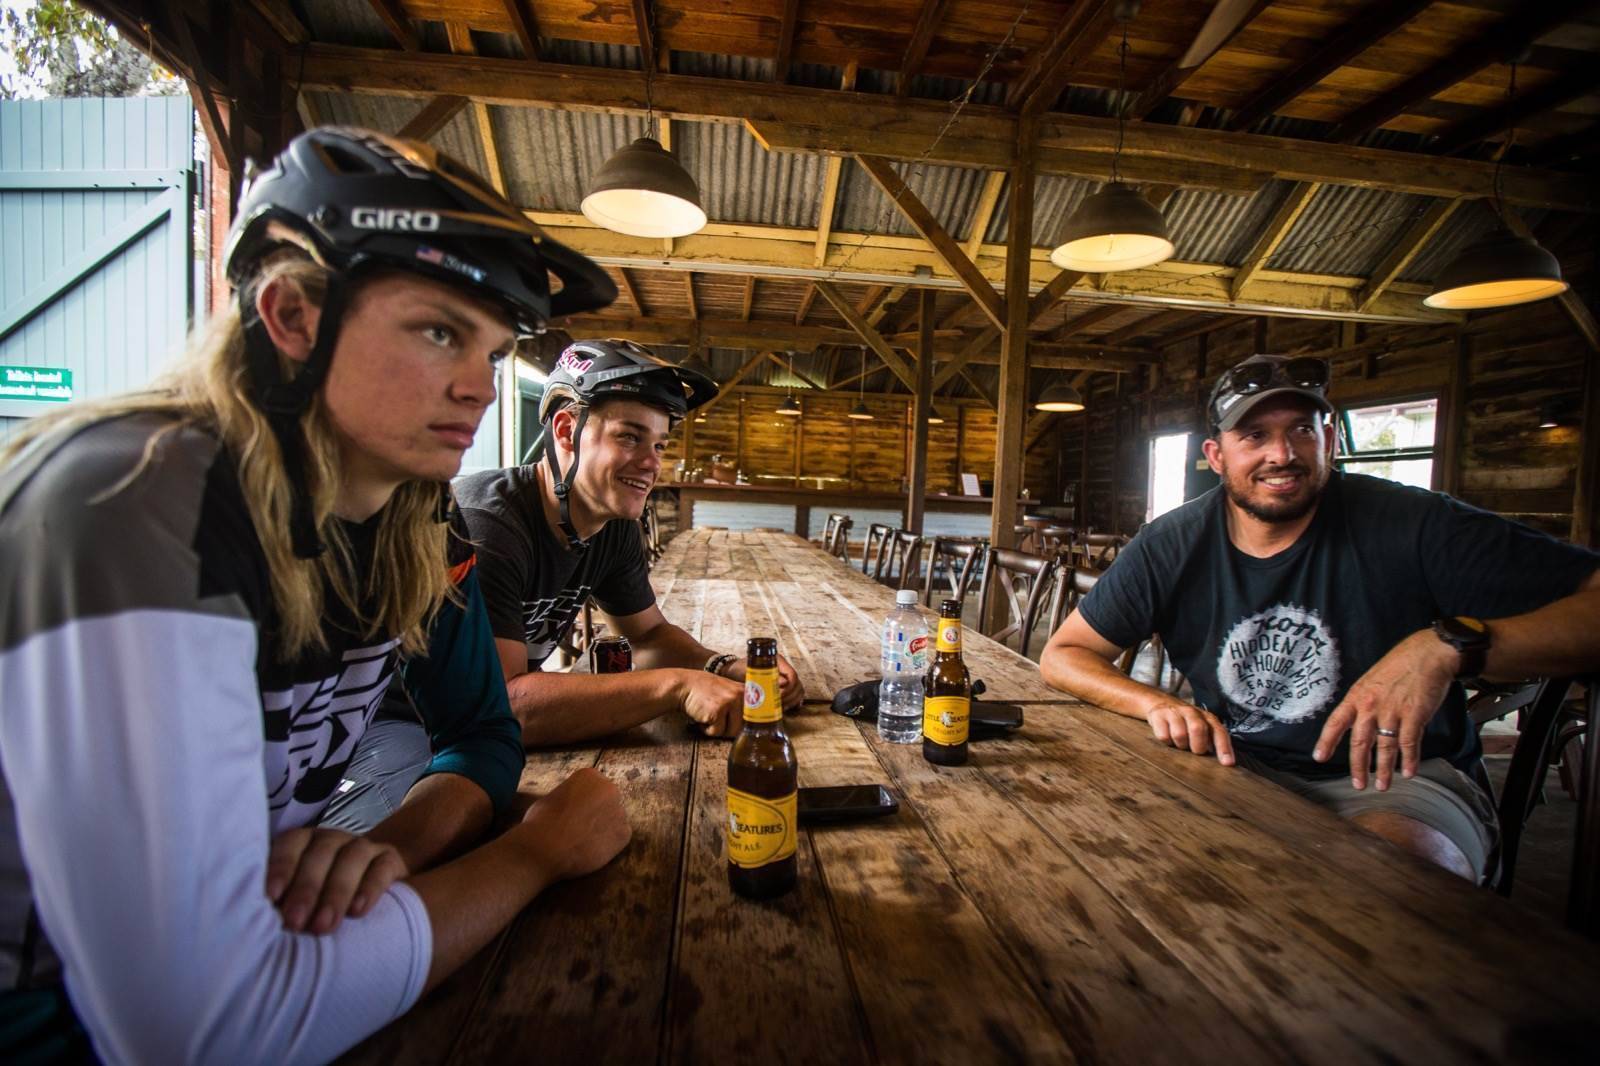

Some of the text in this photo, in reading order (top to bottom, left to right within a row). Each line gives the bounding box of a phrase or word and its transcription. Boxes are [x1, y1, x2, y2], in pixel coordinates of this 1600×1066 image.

[351, 207, 441, 232] GIRO
[1230, 633, 1330, 689] HIDDEN VALE
[1232, 661, 1253, 680] 24
[1254, 654, 1294, 677] HOUR
[1247, 679, 1293, 699] EASTER
[744, 841, 762, 852] ALE
